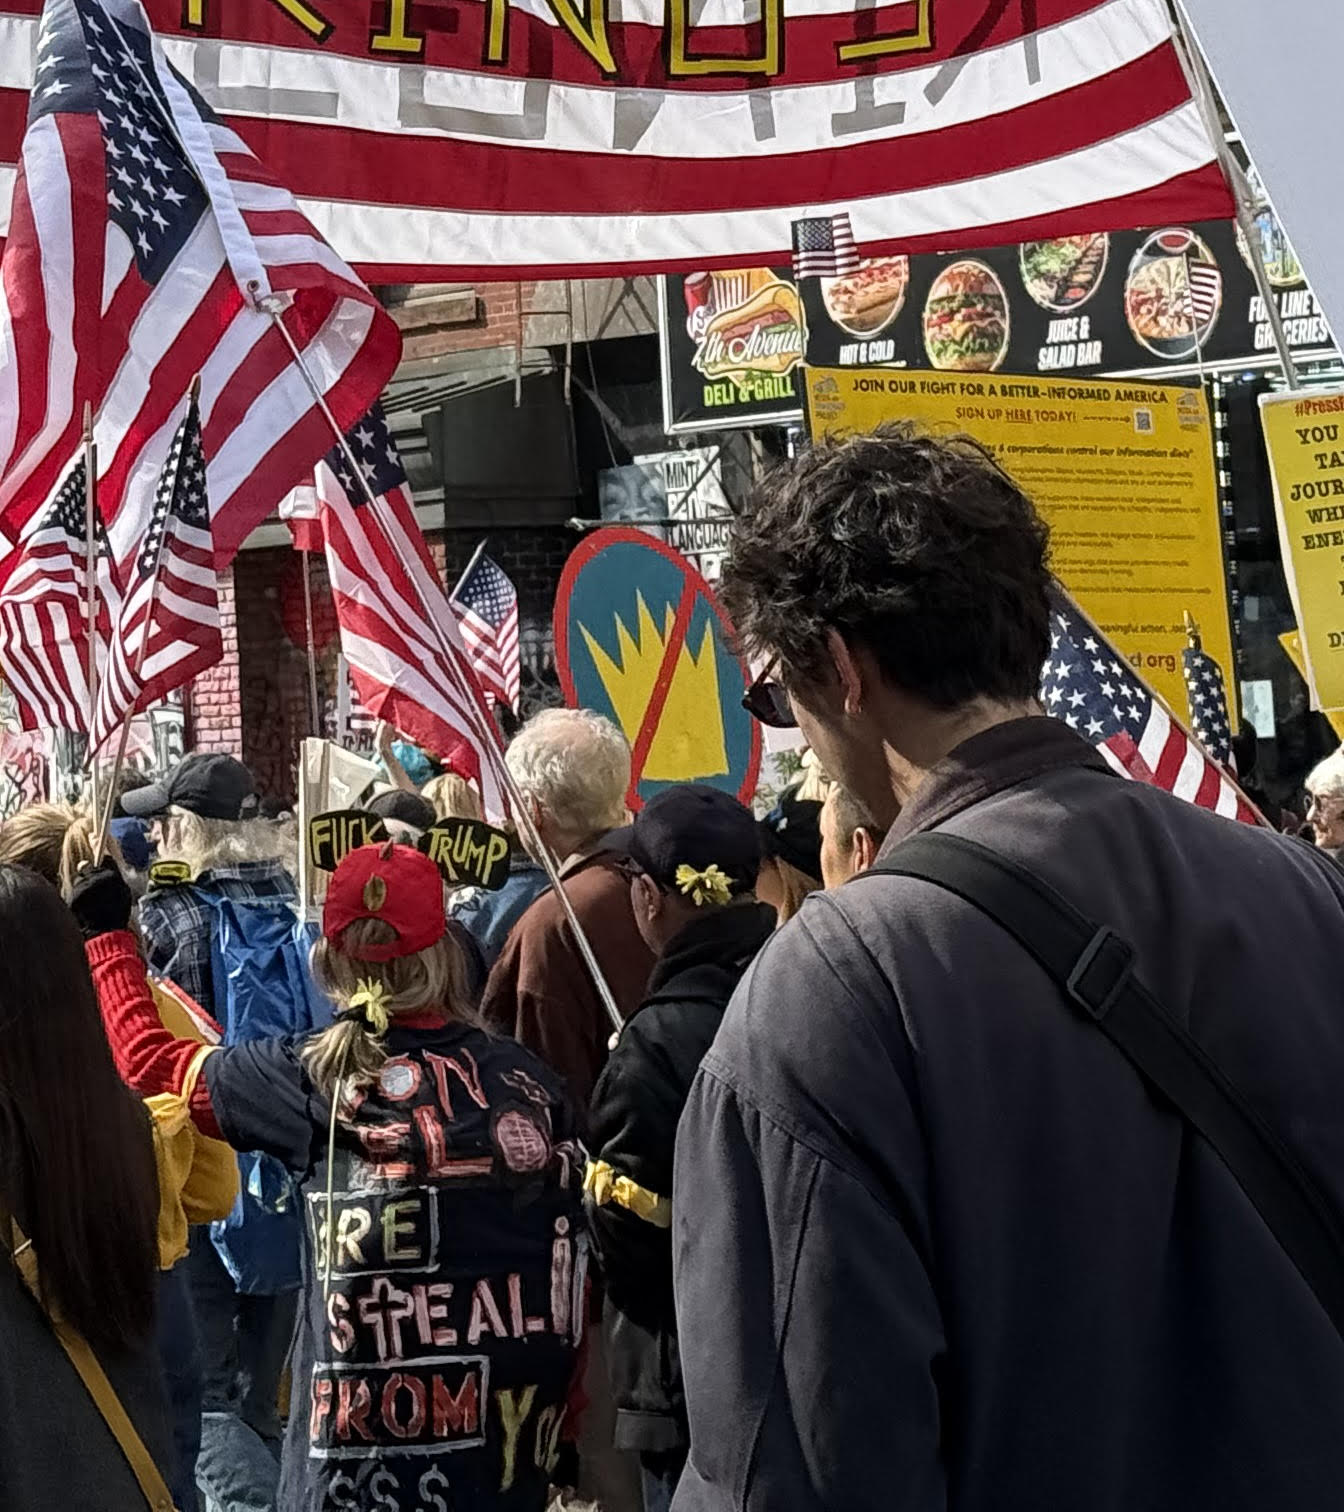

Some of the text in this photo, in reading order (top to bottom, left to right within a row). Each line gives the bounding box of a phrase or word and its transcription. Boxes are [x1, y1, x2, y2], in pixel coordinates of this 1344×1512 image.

[1249, 290, 1311, 322] FU LINE
[1046, 316, 1089, 342] JUICE &
[1254, 318, 1327, 350] GRCERIES
[691, 324, 802, 367] 7th Avenue
[839, 339, 895, 365] HOT & COLD
[1038, 341, 1102, 370] SALAD BAR
[703, 378, 796, 406] DELI & GRILL
[853, 379, 1168, 404] JOIN OUR FIGHT FOR A BETTER-INFORMED AMERICA
[956, 407, 1076, 424] SIGN UP HERE TODAY!
[1296, 424, 1339, 445] YOU
[670, 521, 730, 552] LANGUAG
[312, 817, 507, 885] FUCK TRUMP
[310, 1371, 478, 1442] FROM
